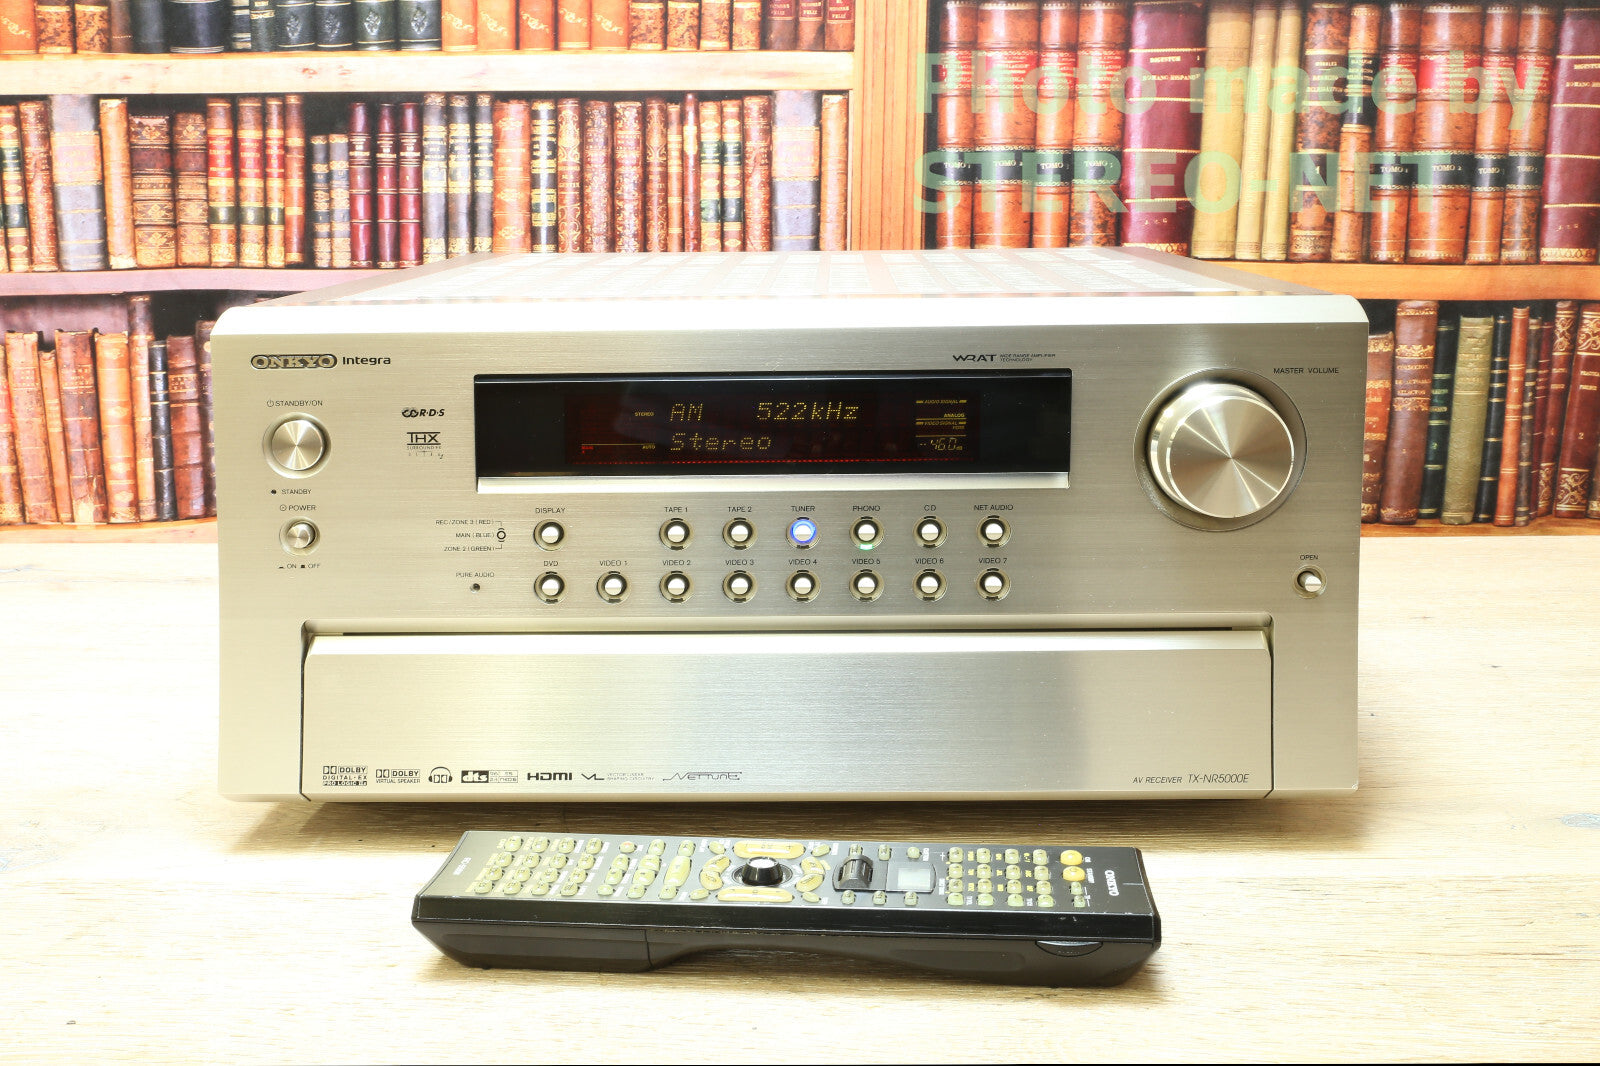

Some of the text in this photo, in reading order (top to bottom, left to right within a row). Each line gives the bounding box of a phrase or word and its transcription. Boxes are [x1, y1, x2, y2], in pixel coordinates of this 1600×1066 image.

[943, 161, 966, 169] TOMO
[251, 354, 391, 369] ONKYO Integra
[670, 401, 859, 421] AM 522kHz
[407, 432, 441, 445] THX
[670, 432, 771, 451] Stereo
[461, 771, 488, 782] dts
[527, 772, 572, 781] HDMI
[1188, 773, 1250, 783] TX-NR5000E
[1104, 869, 1120, 896] ONKYO
